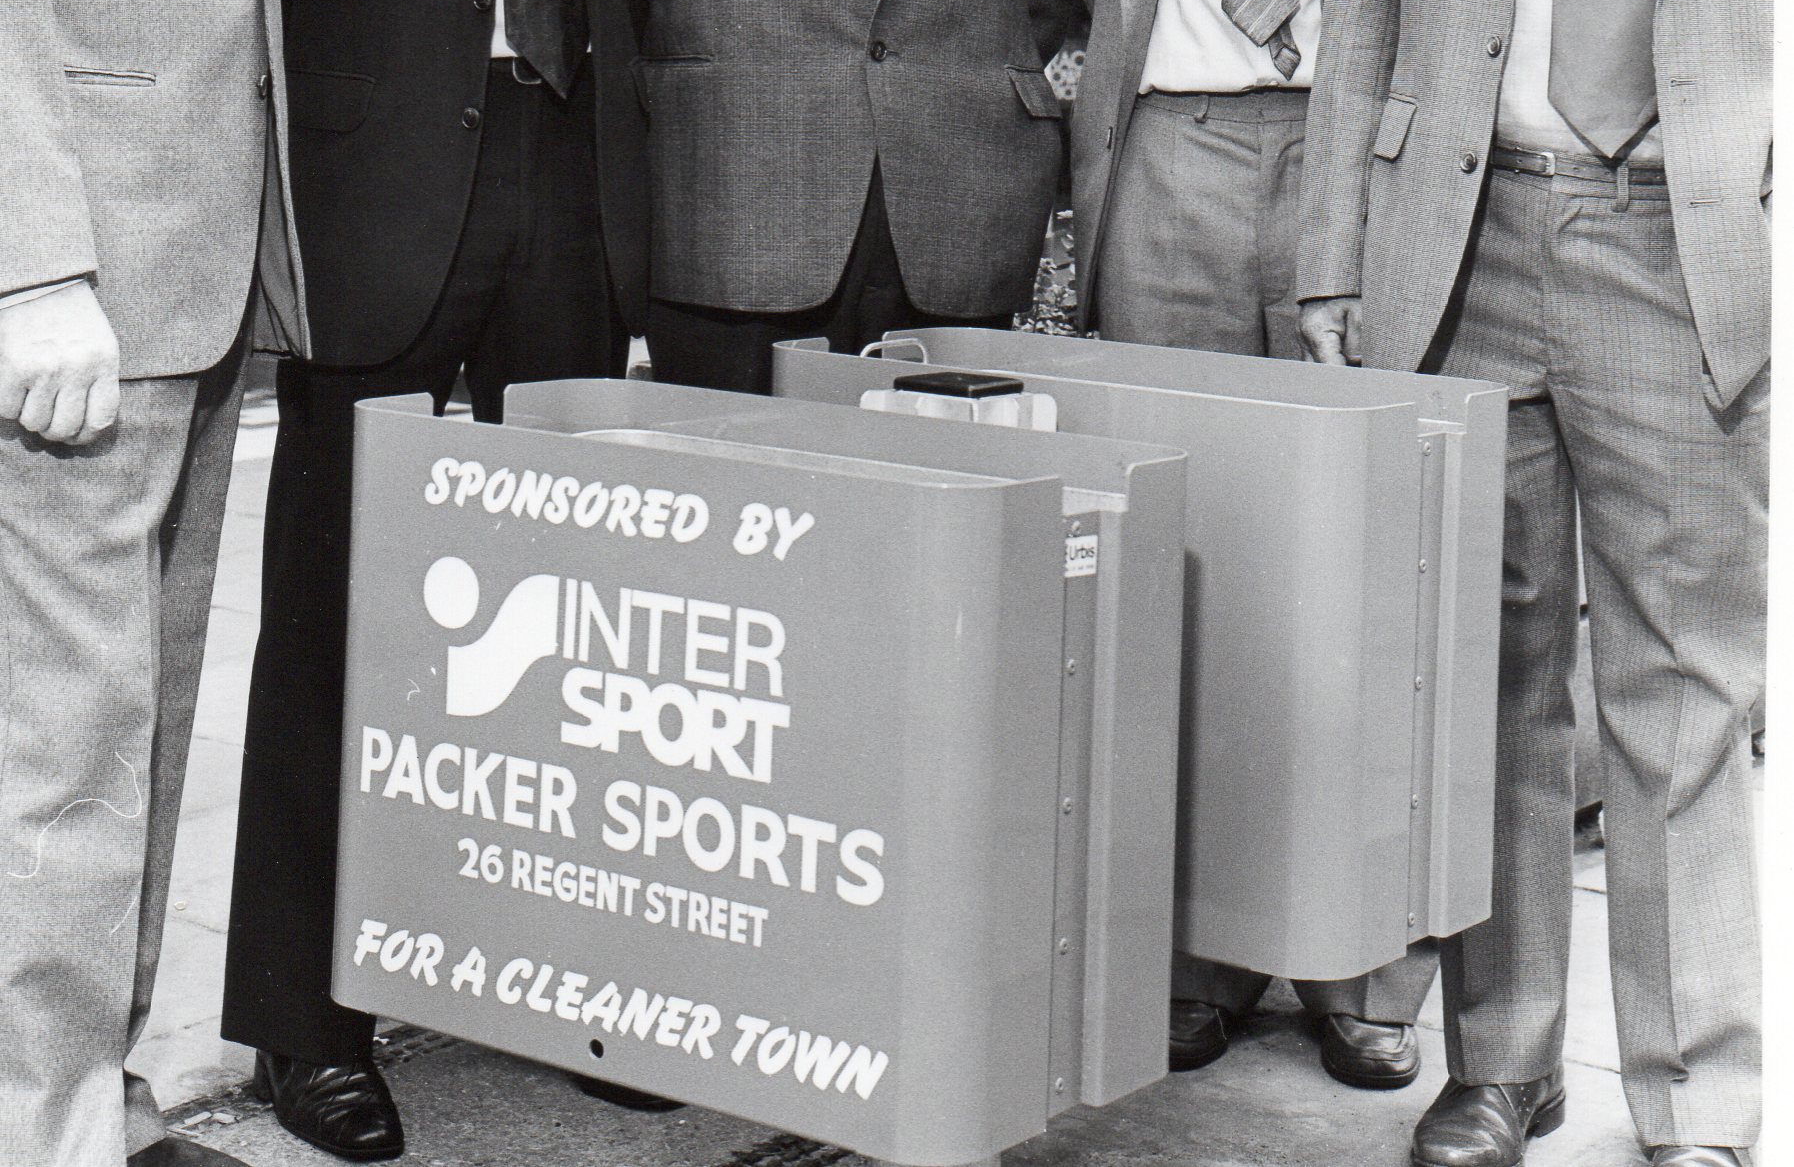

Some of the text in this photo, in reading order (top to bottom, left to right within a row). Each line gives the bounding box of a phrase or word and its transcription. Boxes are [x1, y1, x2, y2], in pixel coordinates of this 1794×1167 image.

[423, 456, 816, 562] SPONSORED BY
[560, 576, 789, 698] INTER
[559, 666, 792, 785] SPORT
[359, 724, 887, 908] PACKER SPORTS
[456, 836, 771, 949] 26 REGENT STREET
[352, 917, 890, 1102] FOR A CLEANER TOWN
